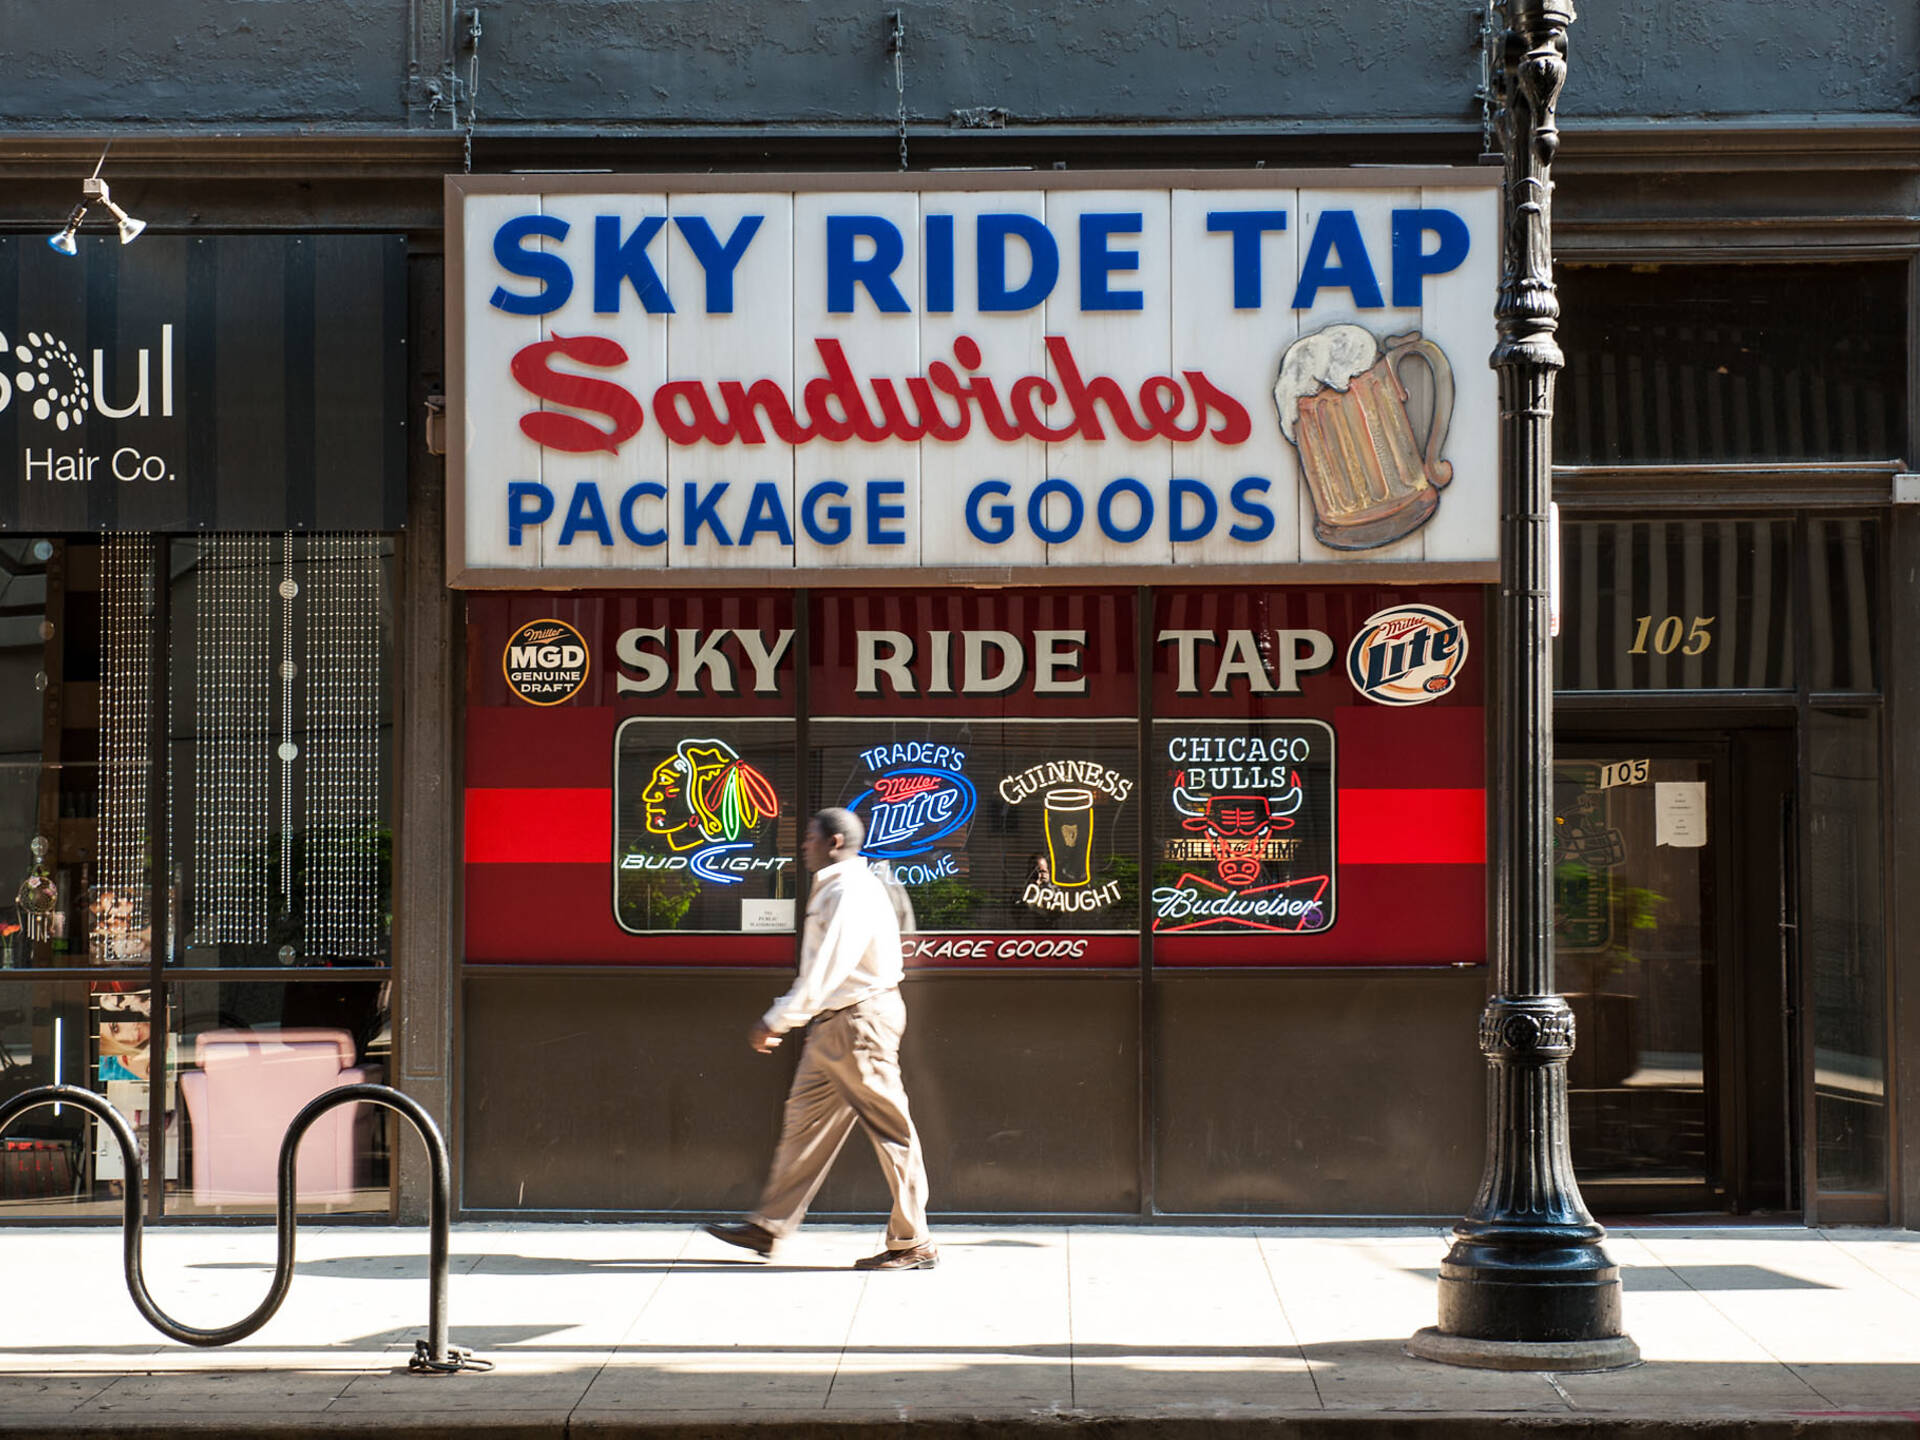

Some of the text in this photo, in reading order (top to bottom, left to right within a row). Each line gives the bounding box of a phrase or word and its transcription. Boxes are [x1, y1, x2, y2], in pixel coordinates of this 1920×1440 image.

[489, 208, 1471, 316] SKY RIDE TAP
[510, 329, 1252, 457] Sandwiches
[25, 447, 175, 482] Hair Co.
[507, 476, 1276, 547] PACKAGE GOODS
[523, 627, 565, 642] Miller
[1379, 616, 1426, 637] Miller
[1626, 614, 1716, 656] 105
[510, 645, 585, 669] MGD
[615, 625, 1335, 695] SKY RIDE TAP
[1365, 624, 1460, 691] Lite
[511, 671, 581, 682] GENUINE
[521, 683, 575, 693] DRAFT
[860, 741, 966, 772] TRADER'S
[1168, 737, 1311, 762] CHICAGO
[874, 776, 942, 797] Miller
[999, 760, 1134, 805] GUINNESS
[1186, 765, 1287, 790] BULLS
[1606, 761, 1648, 786] 105
[863, 788, 959, 849] Lite
[620, 854, 793, 871] BUD LIGHT
[868, 854, 959, 886] ELCOME
[1022, 880, 1122, 912] DRAUGHT
[1151, 887, 1323, 918] Budweiser
[901, 940, 1088, 958] CKAGE GOODS
